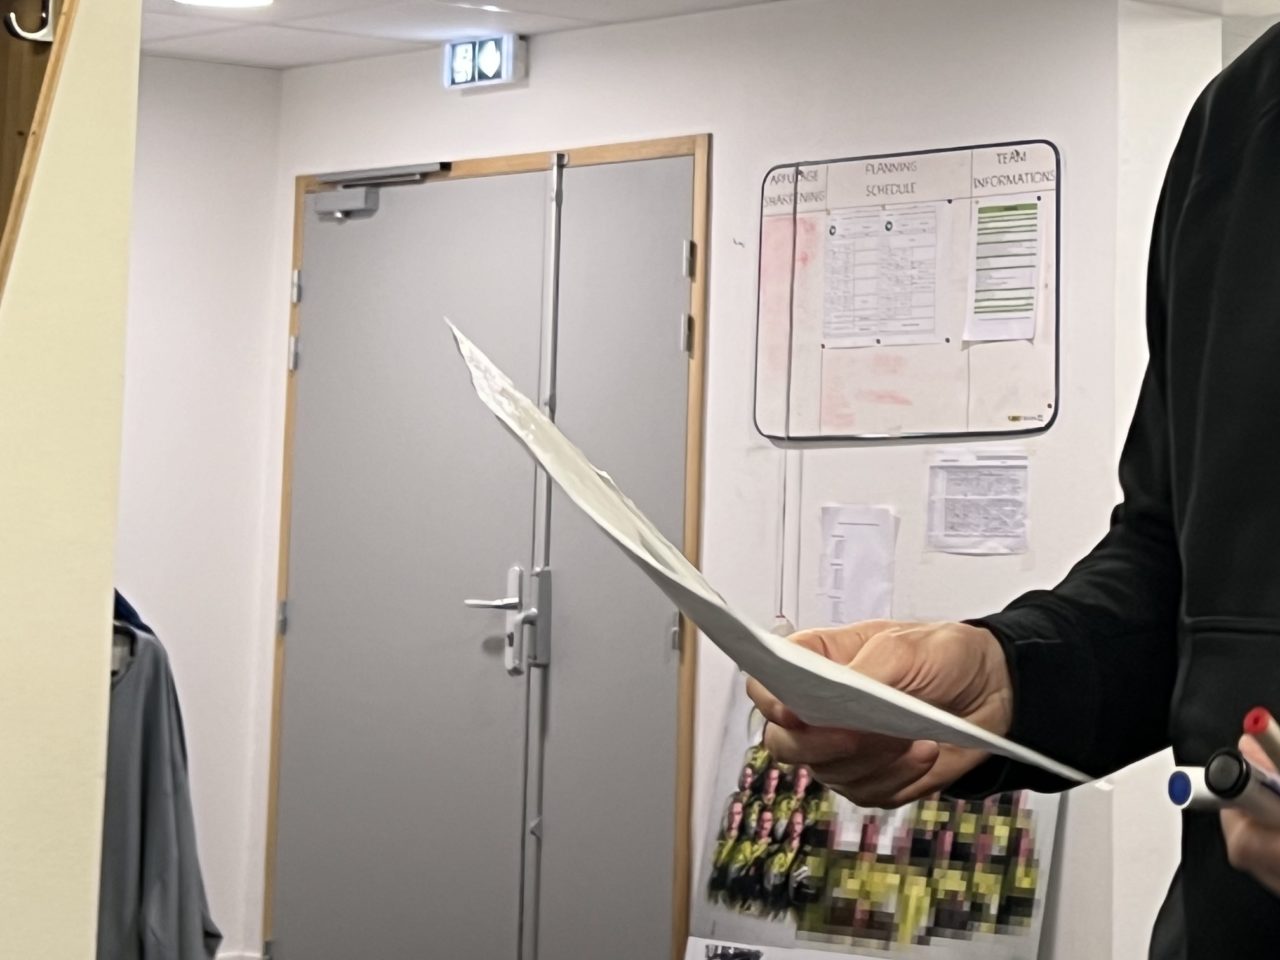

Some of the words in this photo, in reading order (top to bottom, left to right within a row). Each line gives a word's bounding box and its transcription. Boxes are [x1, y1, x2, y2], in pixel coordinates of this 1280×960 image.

[996, 150, 1026, 164] TEAM
[865, 161, 918, 175] PLANNING
[974, 170, 1055, 189] INFORMATIONS
[866, 182, 917, 196] SCHEDULE
